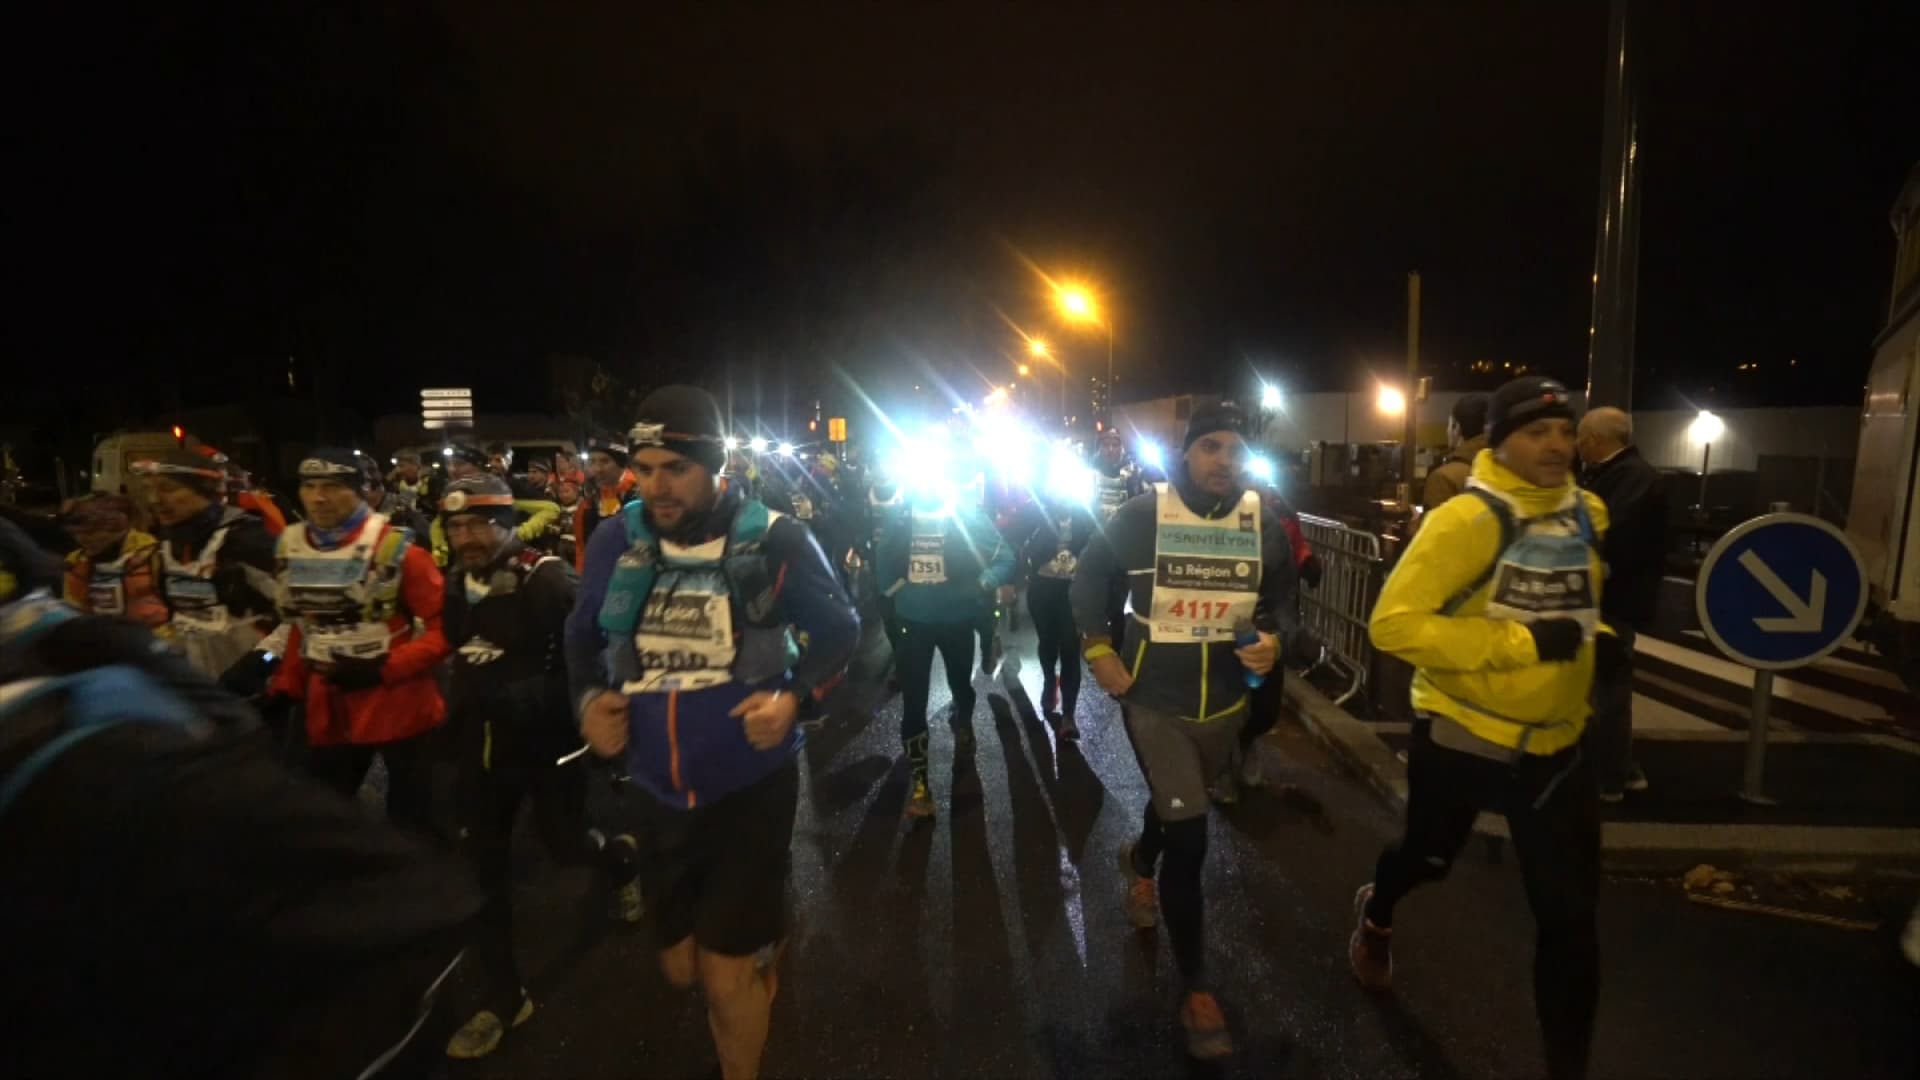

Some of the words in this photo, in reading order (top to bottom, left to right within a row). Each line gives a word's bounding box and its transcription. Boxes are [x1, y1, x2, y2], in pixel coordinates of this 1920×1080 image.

[1167, 563, 1184, 576] La
[1186, 563, 1231, 579] Région
[1168, 600, 1230, 620] 4117
